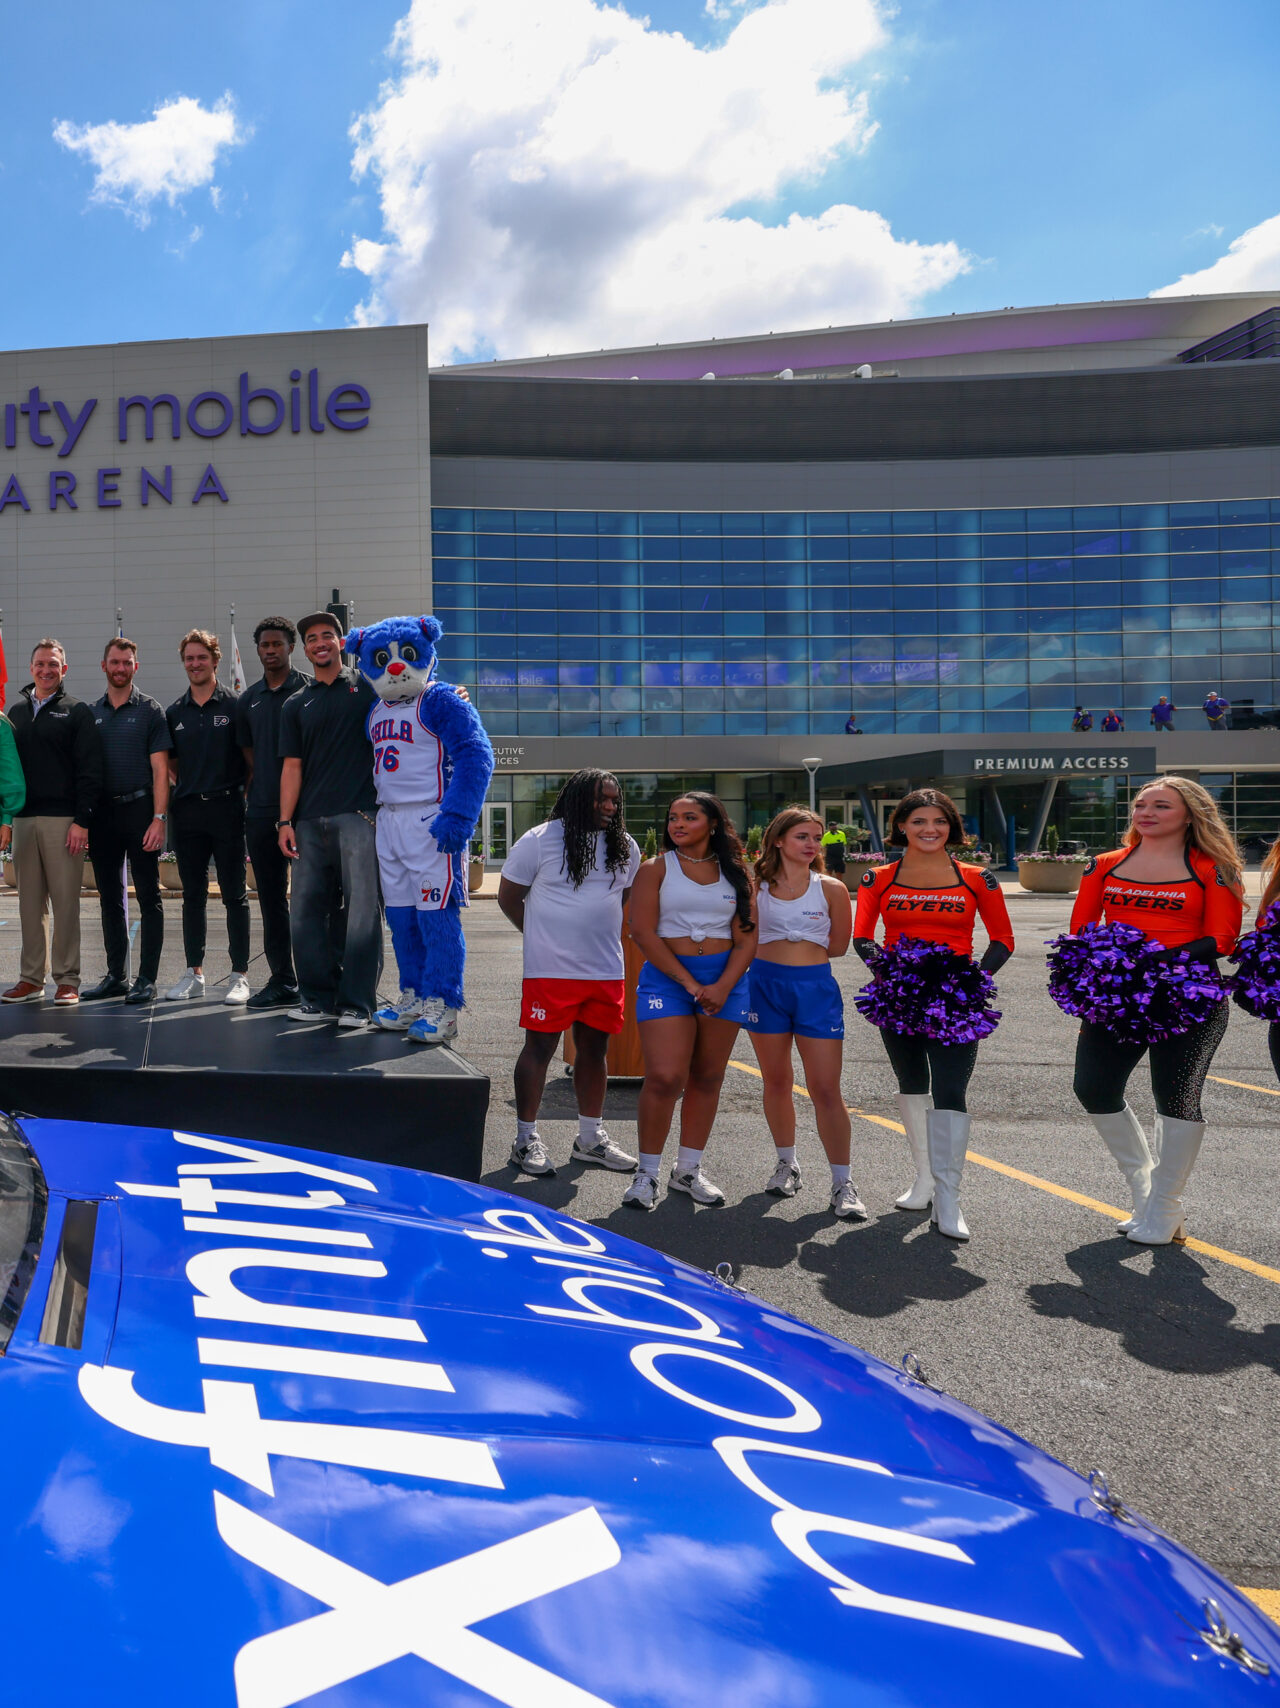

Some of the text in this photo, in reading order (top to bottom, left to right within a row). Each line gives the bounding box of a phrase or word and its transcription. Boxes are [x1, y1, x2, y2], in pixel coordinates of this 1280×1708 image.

[118, 368, 371, 441] mobile
[493, 747, 525, 755] CUTIVE
[375, 745, 400, 775] 76
[494, 757, 520, 765] ICES
[974, 756, 1129, 770] PREMIUM ACCESS
[421, 888, 441, 902] 76
[889, 894, 965, 902] PHILADELPHIA
[1104, 886, 1187, 899] PHILADELPHIA
[886, 901, 966, 913] FLYERS
[1103, 893, 1185, 911] FLYERS
[648, 999, 663, 1010] 76
[530, 1007, 546, 1021] 76
[747, 1012, 759, 1024] 76
[78, 1131, 621, 1708] xfinity
[463, 1209, 1084, 1659] mobile
